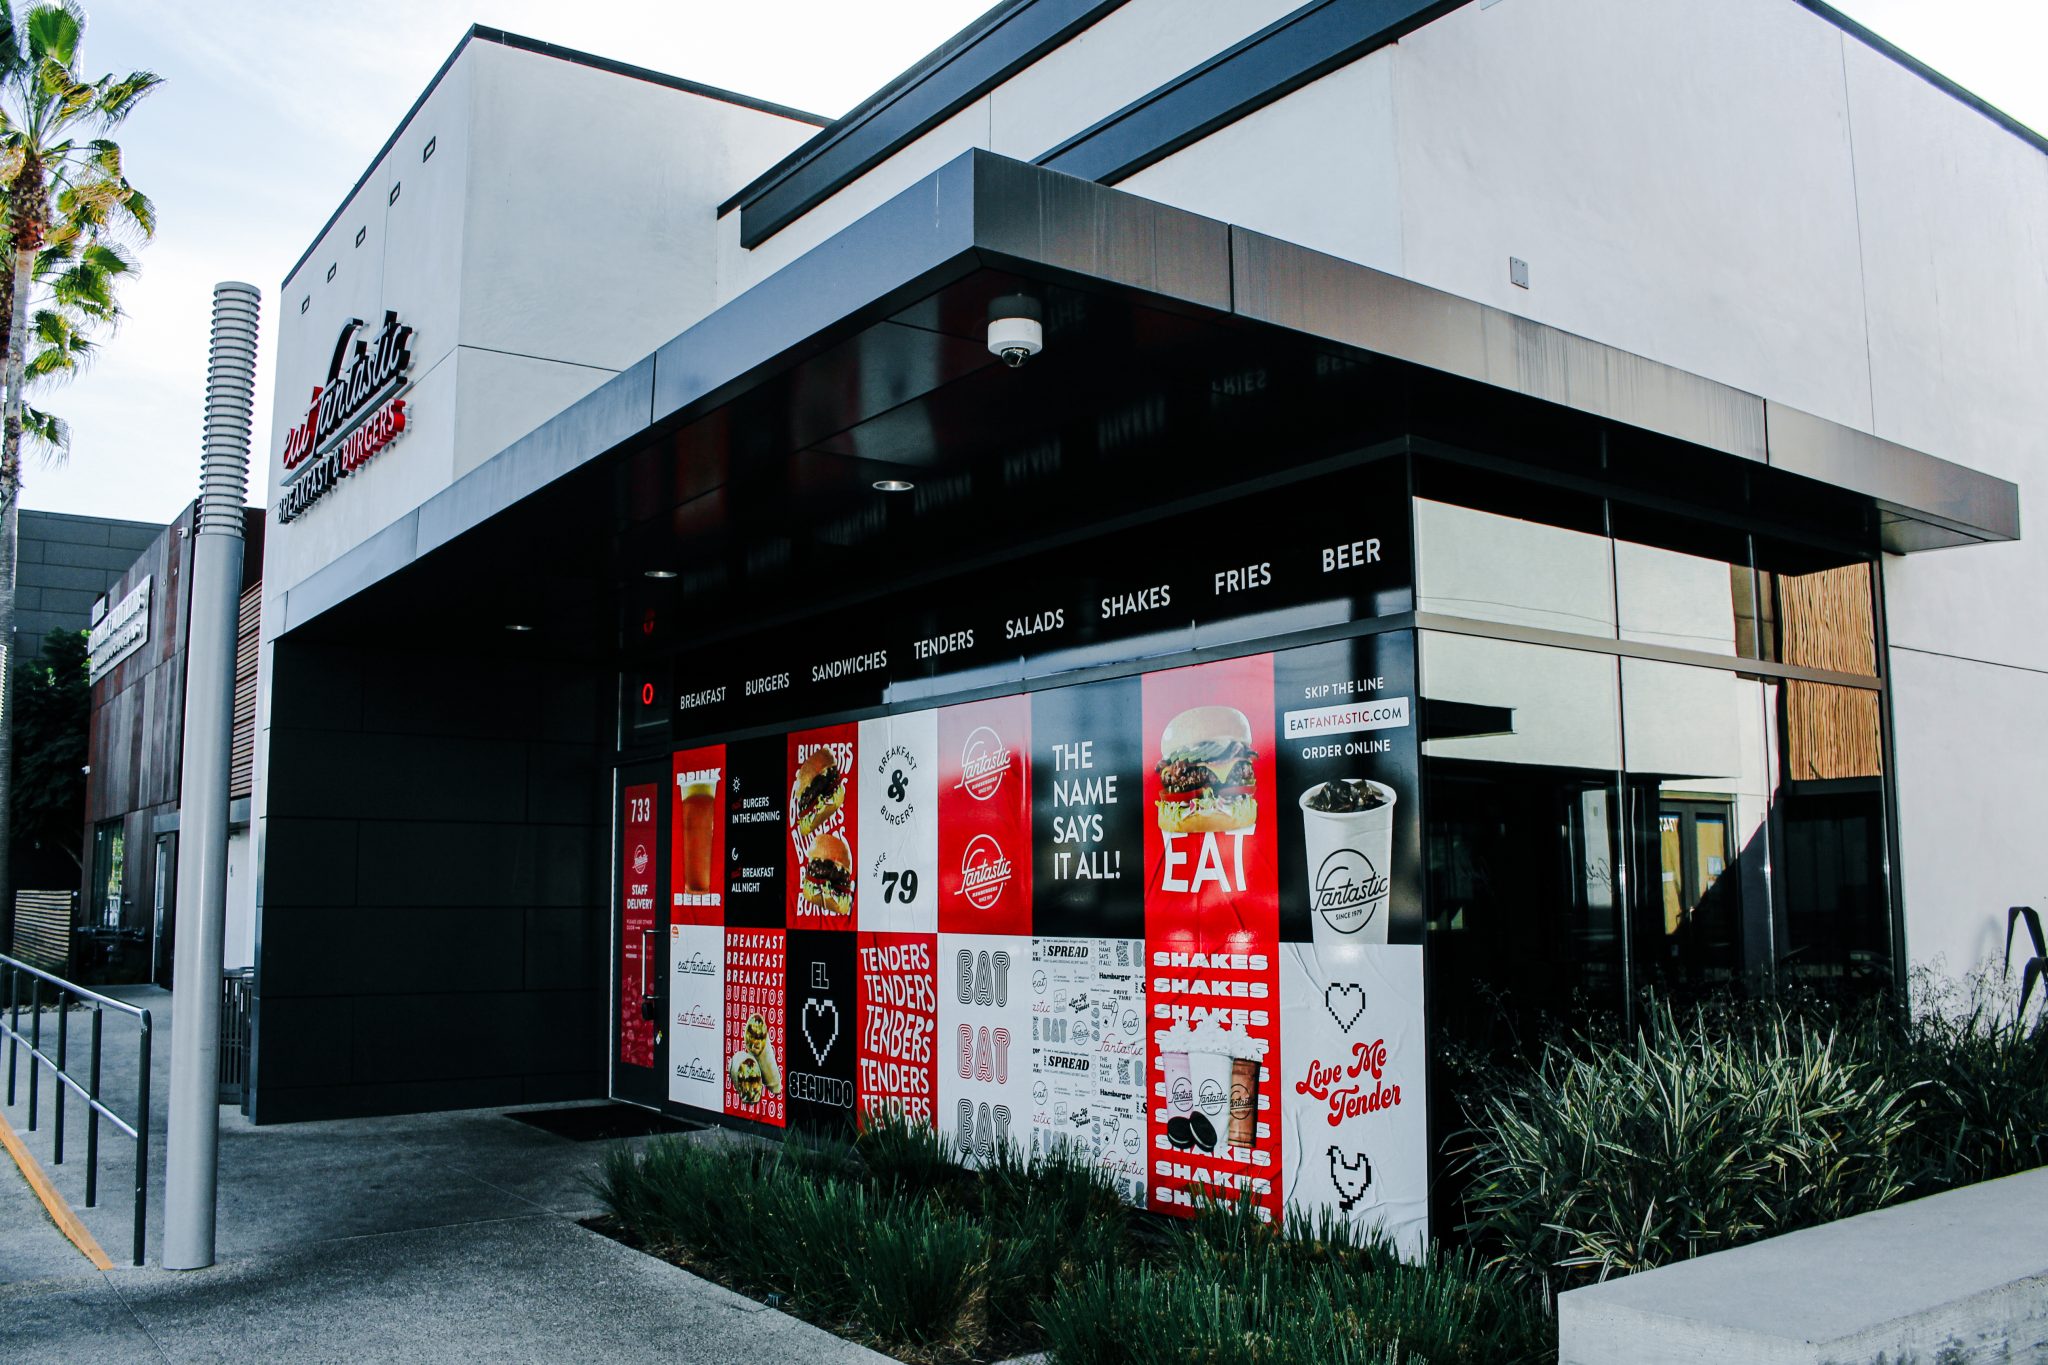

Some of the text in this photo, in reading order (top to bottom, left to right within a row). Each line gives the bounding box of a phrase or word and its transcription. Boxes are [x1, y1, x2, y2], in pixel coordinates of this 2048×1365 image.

[284, 387, 323, 469] eat
[278, 399, 405, 523] BREAKFAST & BURGERS
[680, 538, 1381, 710] BREAKFAST BURGERS SANDWICHES TENDERS SALADS SHAKES FRIES BEER
[1305, 677, 1384, 699] SKIP THE LINE
[1290, 707, 1402, 731] EATFANTASTIC.COM
[798, 742, 854, 774] BUERS
[878, 745, 918, 774] BREAKFAST
[1052, 740, 1093, 772] THE
[1302, 739, 1391, 760] ORDER ONLINE
[887, 769, 909, 802] &
[1053, 775, 1118, 807] NAME
[631, 797, 651, 823] 733
[743, 797, 770, 808] BURGERS
[880, 803, 914, 826] BURGERS
[732, 811, 780, 824] IN THE MORNING
[1053, 814, 1104, 844] SAYS
[873, 852, 886, 878] SINCE
[1054, 851, 1121, 880] IT ALL!
[1161, 823, 1256, 893] EAT
[742, 867, 774, 878] BREAKFAST
[631, 884, 649, 895] STAFF
[731, 882, 760, 892] ALL NIGHT
[881, 869, 919, 904] 79
[626, 898, 654, 910] DELIVERY
[1335, 909, 1363, 920] SINCE 1979
[726, 934, 784, 949] BREAKFAST
[1047, 945, 1089, 957] SPREAD
[726, 952, 784, 968] BREAKFAST
[860, 943, 930, 971] TENDERS
[1153, 951, 1268, 970] SHAKES
[726, 969, 784, 986] BREAKFAST
[811, 962, 829, 989] EL
[957, 949, 1010, 1007] EAT
[1099, 972, 1131, 982] Hamburger
[1153, 977, 1269, 998] SHAKES
[726, 985, 784, 1006] BURRITOS
[863, 974, 936, 1013] TENDERS
[1154, 1003, 1269, 1026] SHAKES
[957, 1023, 1010, 1084] EAT
[1048, 1055, 1089, 1071] SPREAD
[860, 1058, 930, 1094] TENDERS
[1295, 1059, 1342, 1101] Love
[1347, 1038, 1387, 1080] Me
[789, 1071, 853, 1108] SEGUNDO
[1100, 1089, 1132, 1100] Hamburger
[1327, 1081, 1402, 1127] Tender
[1155, 1134, 1271, 1166] SKES
